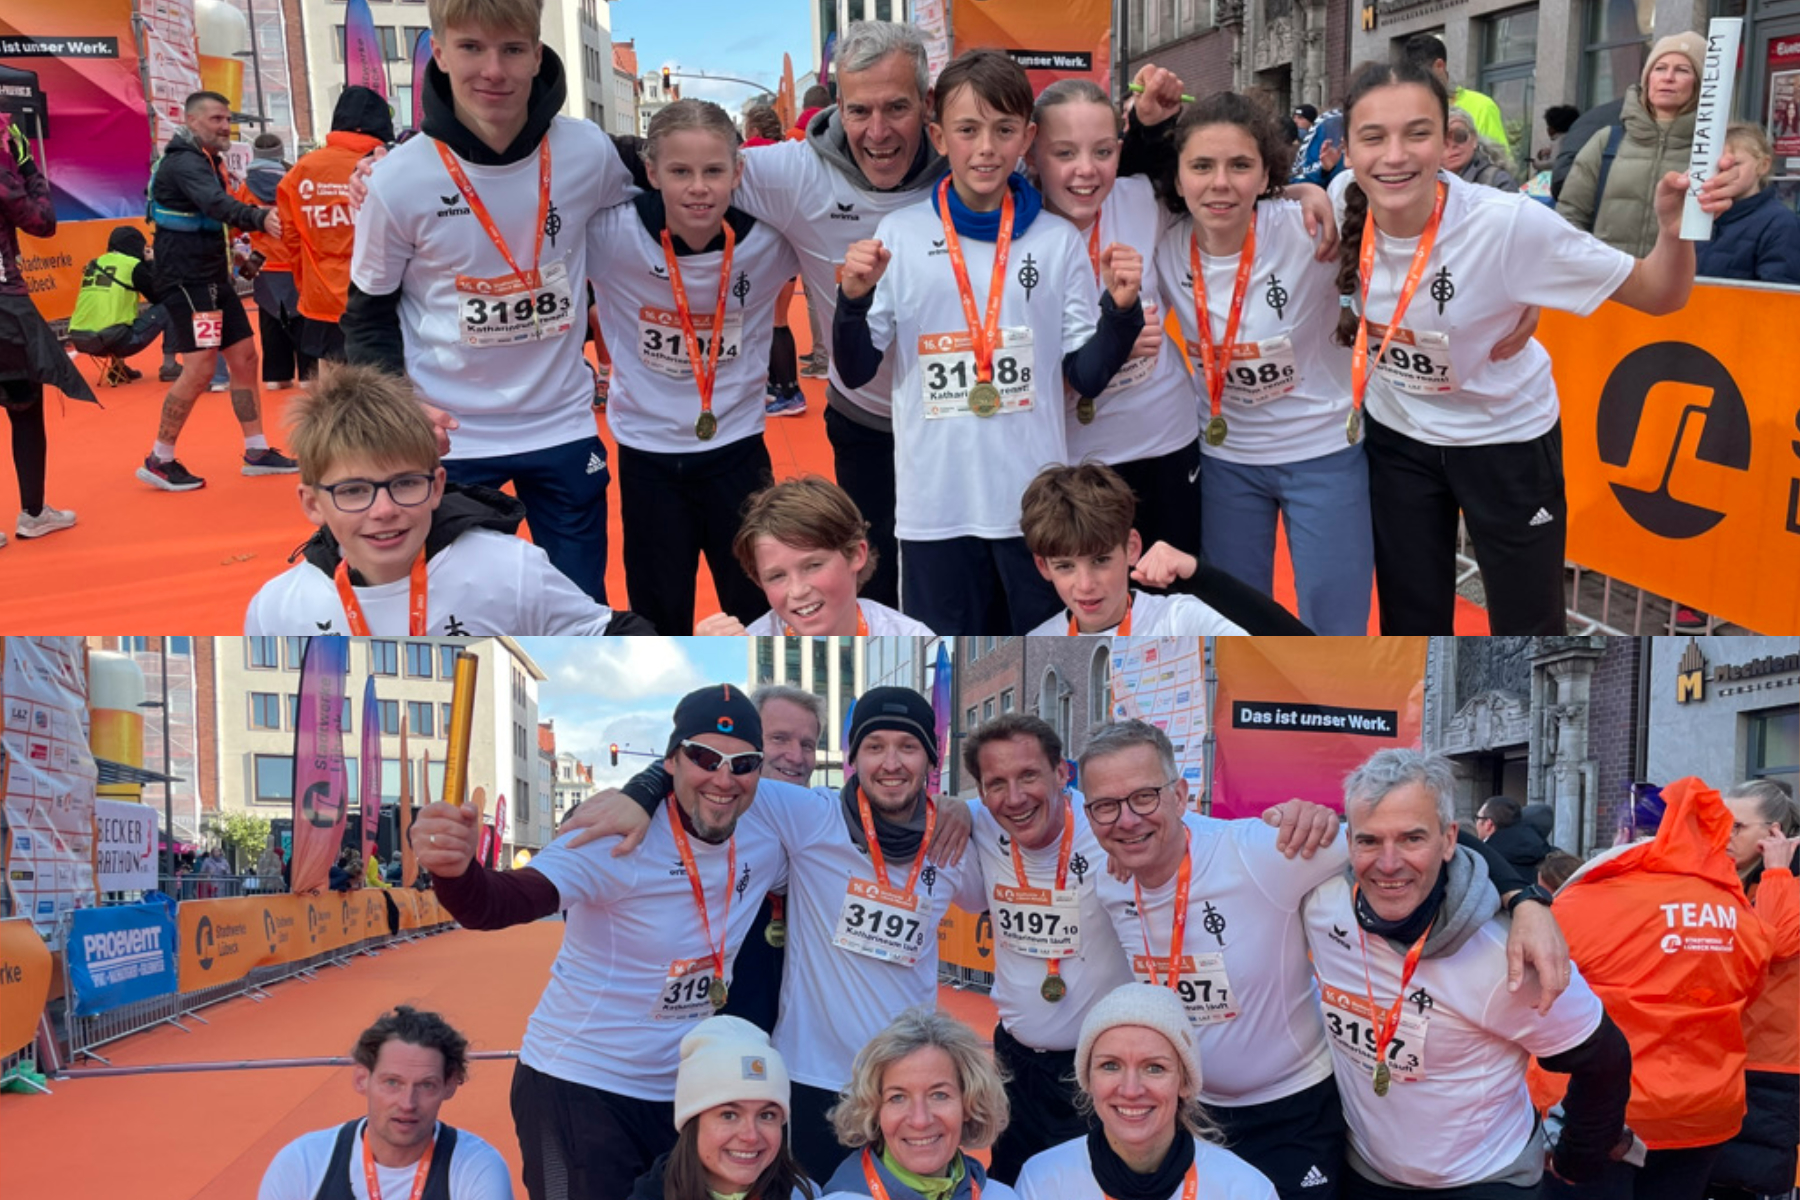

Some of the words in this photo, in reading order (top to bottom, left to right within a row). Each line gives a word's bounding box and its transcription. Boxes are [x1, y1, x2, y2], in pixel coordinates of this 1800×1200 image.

[22, 43, 64, 53] unser
[66, 42, 112, 54] Werk.
[1017, 56, 1051, 66] unser
[1052, 55, 1087, 67] Werk.
[1688, 34, 1726, 198] KATHARINEUM
[436, 207, 471, 217] erima
[28, 274, 57, 293] übeck
[466, 292, 557, 324] 3198
[560, 297, 570, 310] 3
[727, 344, 737, 357] 4
[1367, 343, 1434, 375] 198
[1436, 365, 1449, 376] 7
[927, 357, 1018, 390] 318
[1021, 367, 1031, 382] 8
[1282, 365, 1294, 376] 6
[930, 390, 968, 400] Kathari
[1240, 708, 1272, 724] Das
[1275, 709, 1298, 725] ist
[1300, 713, 1347, 728] unser
[1348, 715, 1391, 731] Werk.
[98, 817, 143, 844] BECKER
[98, 850, 141, 874] RATHON
[845, 903, 920, 942] 3197
[916, 932, 924, 946] 8
[999, 908, 1061, 936] 3197
[1063, 925, 1079, 936] 10
[1660, 903, 1737, 930] TEAM
[846, 926, 902, 948] Katharineum
[663, 976, 712, 1005] 319
[1216, 988, 1228, 1002] 7
[1326, 1012, 1406, 1060] 3197
[1407, 1053, 1419, 1067] 3
